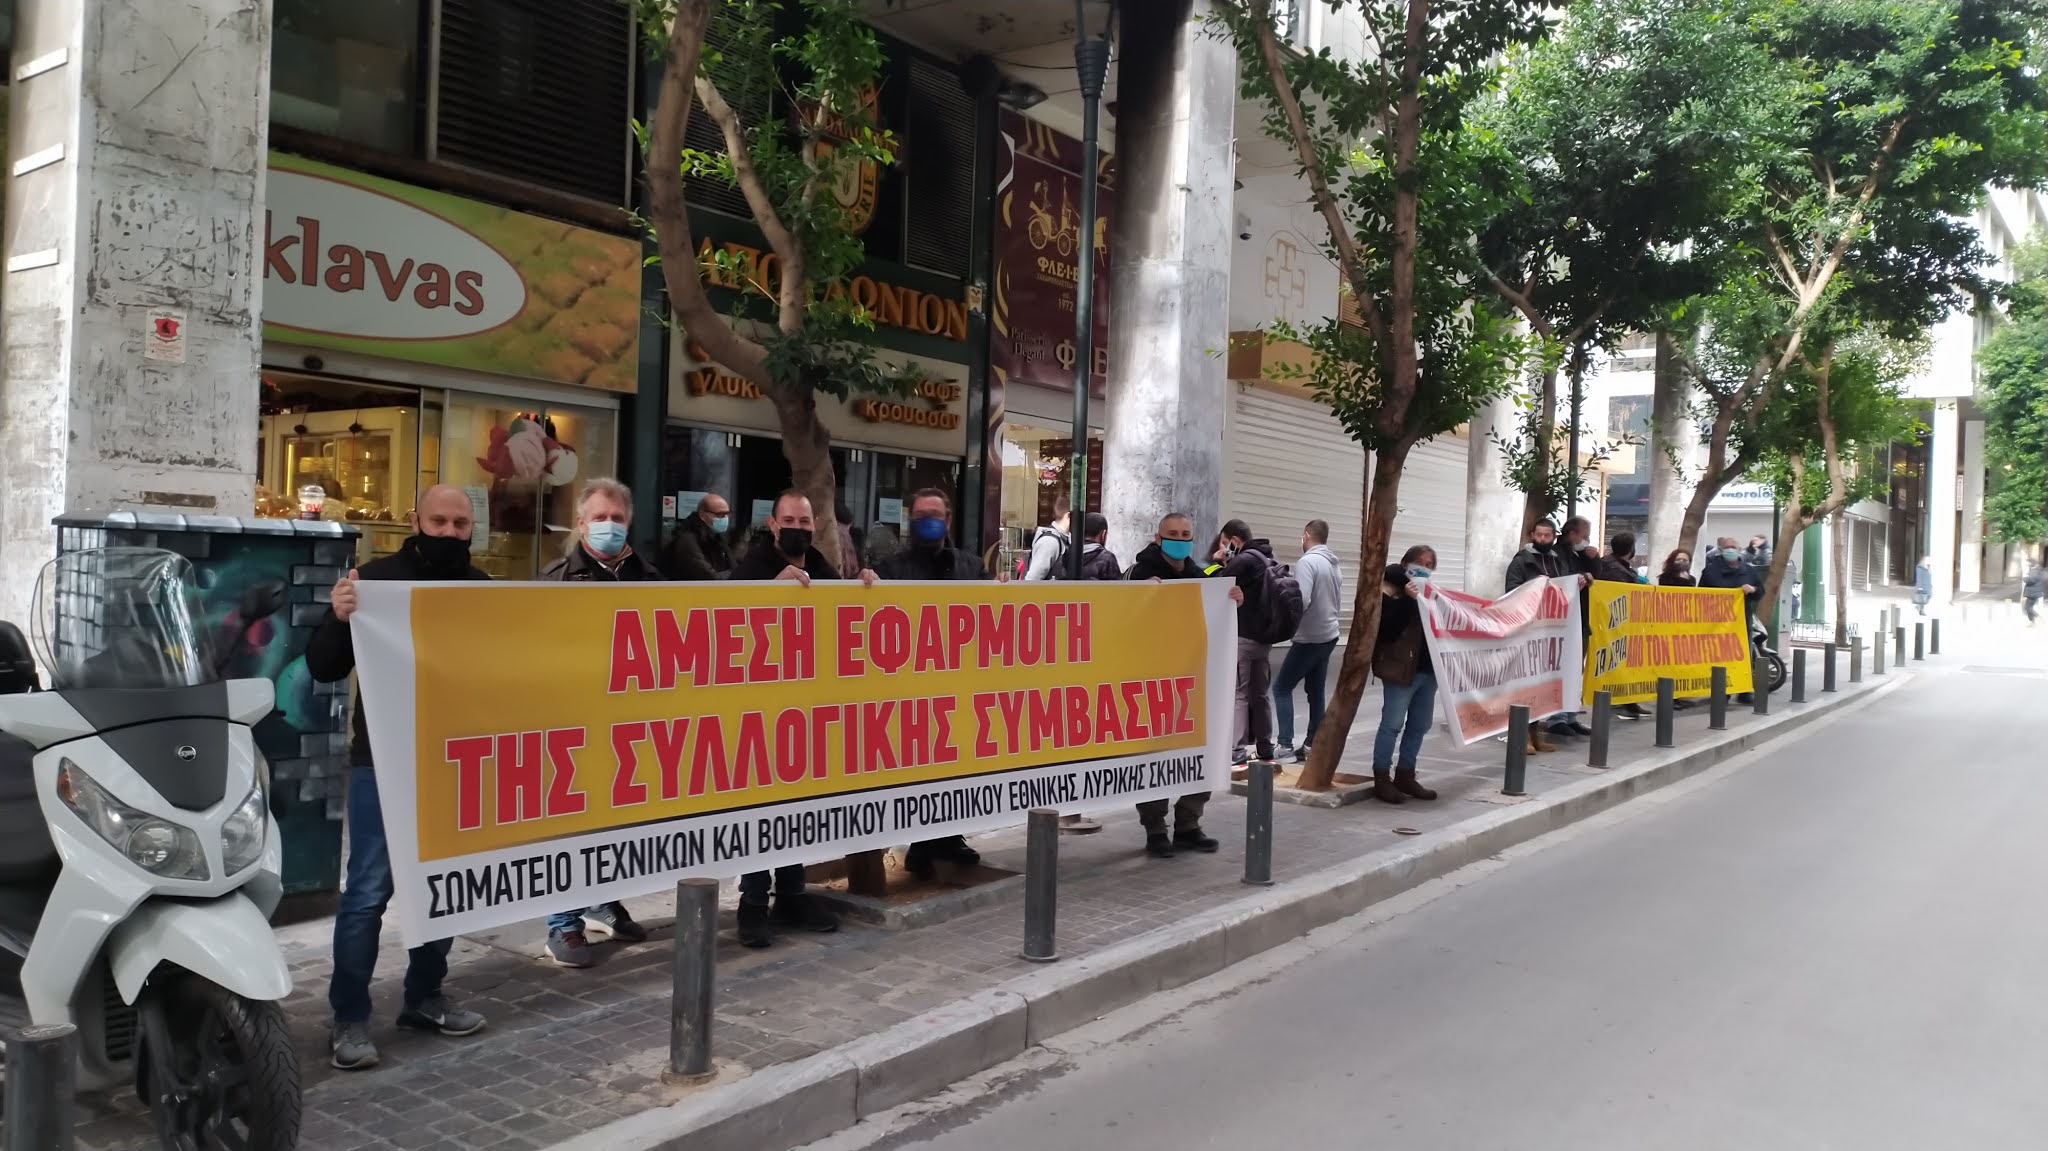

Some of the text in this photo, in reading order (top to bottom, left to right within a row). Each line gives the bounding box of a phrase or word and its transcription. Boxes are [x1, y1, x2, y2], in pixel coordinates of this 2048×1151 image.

[1058, 298, 1074, 312] 1972
[608, 601, 1092, 694] ΑΜΕΣΗ ΕΦΑΡΜΟΓΗ
[1647, 634, 1671, 666] ΤΟΝ
[1671, 632, 1745, 665] ΠΟΛΙΤΙΣΜΟ
[445, 675, 1197, 832] ΤΗΣ ΣΥΛΛΟΓΙΚΗΣ ΣΥΜΒΑΣΗΣ
[426, 754, 1205, 919] ΣΩΜΑΤΕΙΟ ΤΕΧΝΙΚΩΝ ΚΑΙ ΒΟΗΘΗΤΙΚΟΥ ΠΡΟΣΩΠΙΚΟΥ ΕΘΝΙΚΗΣ ΛΥΡΙΚΗΣ ΣΚΗΝΗΣ
